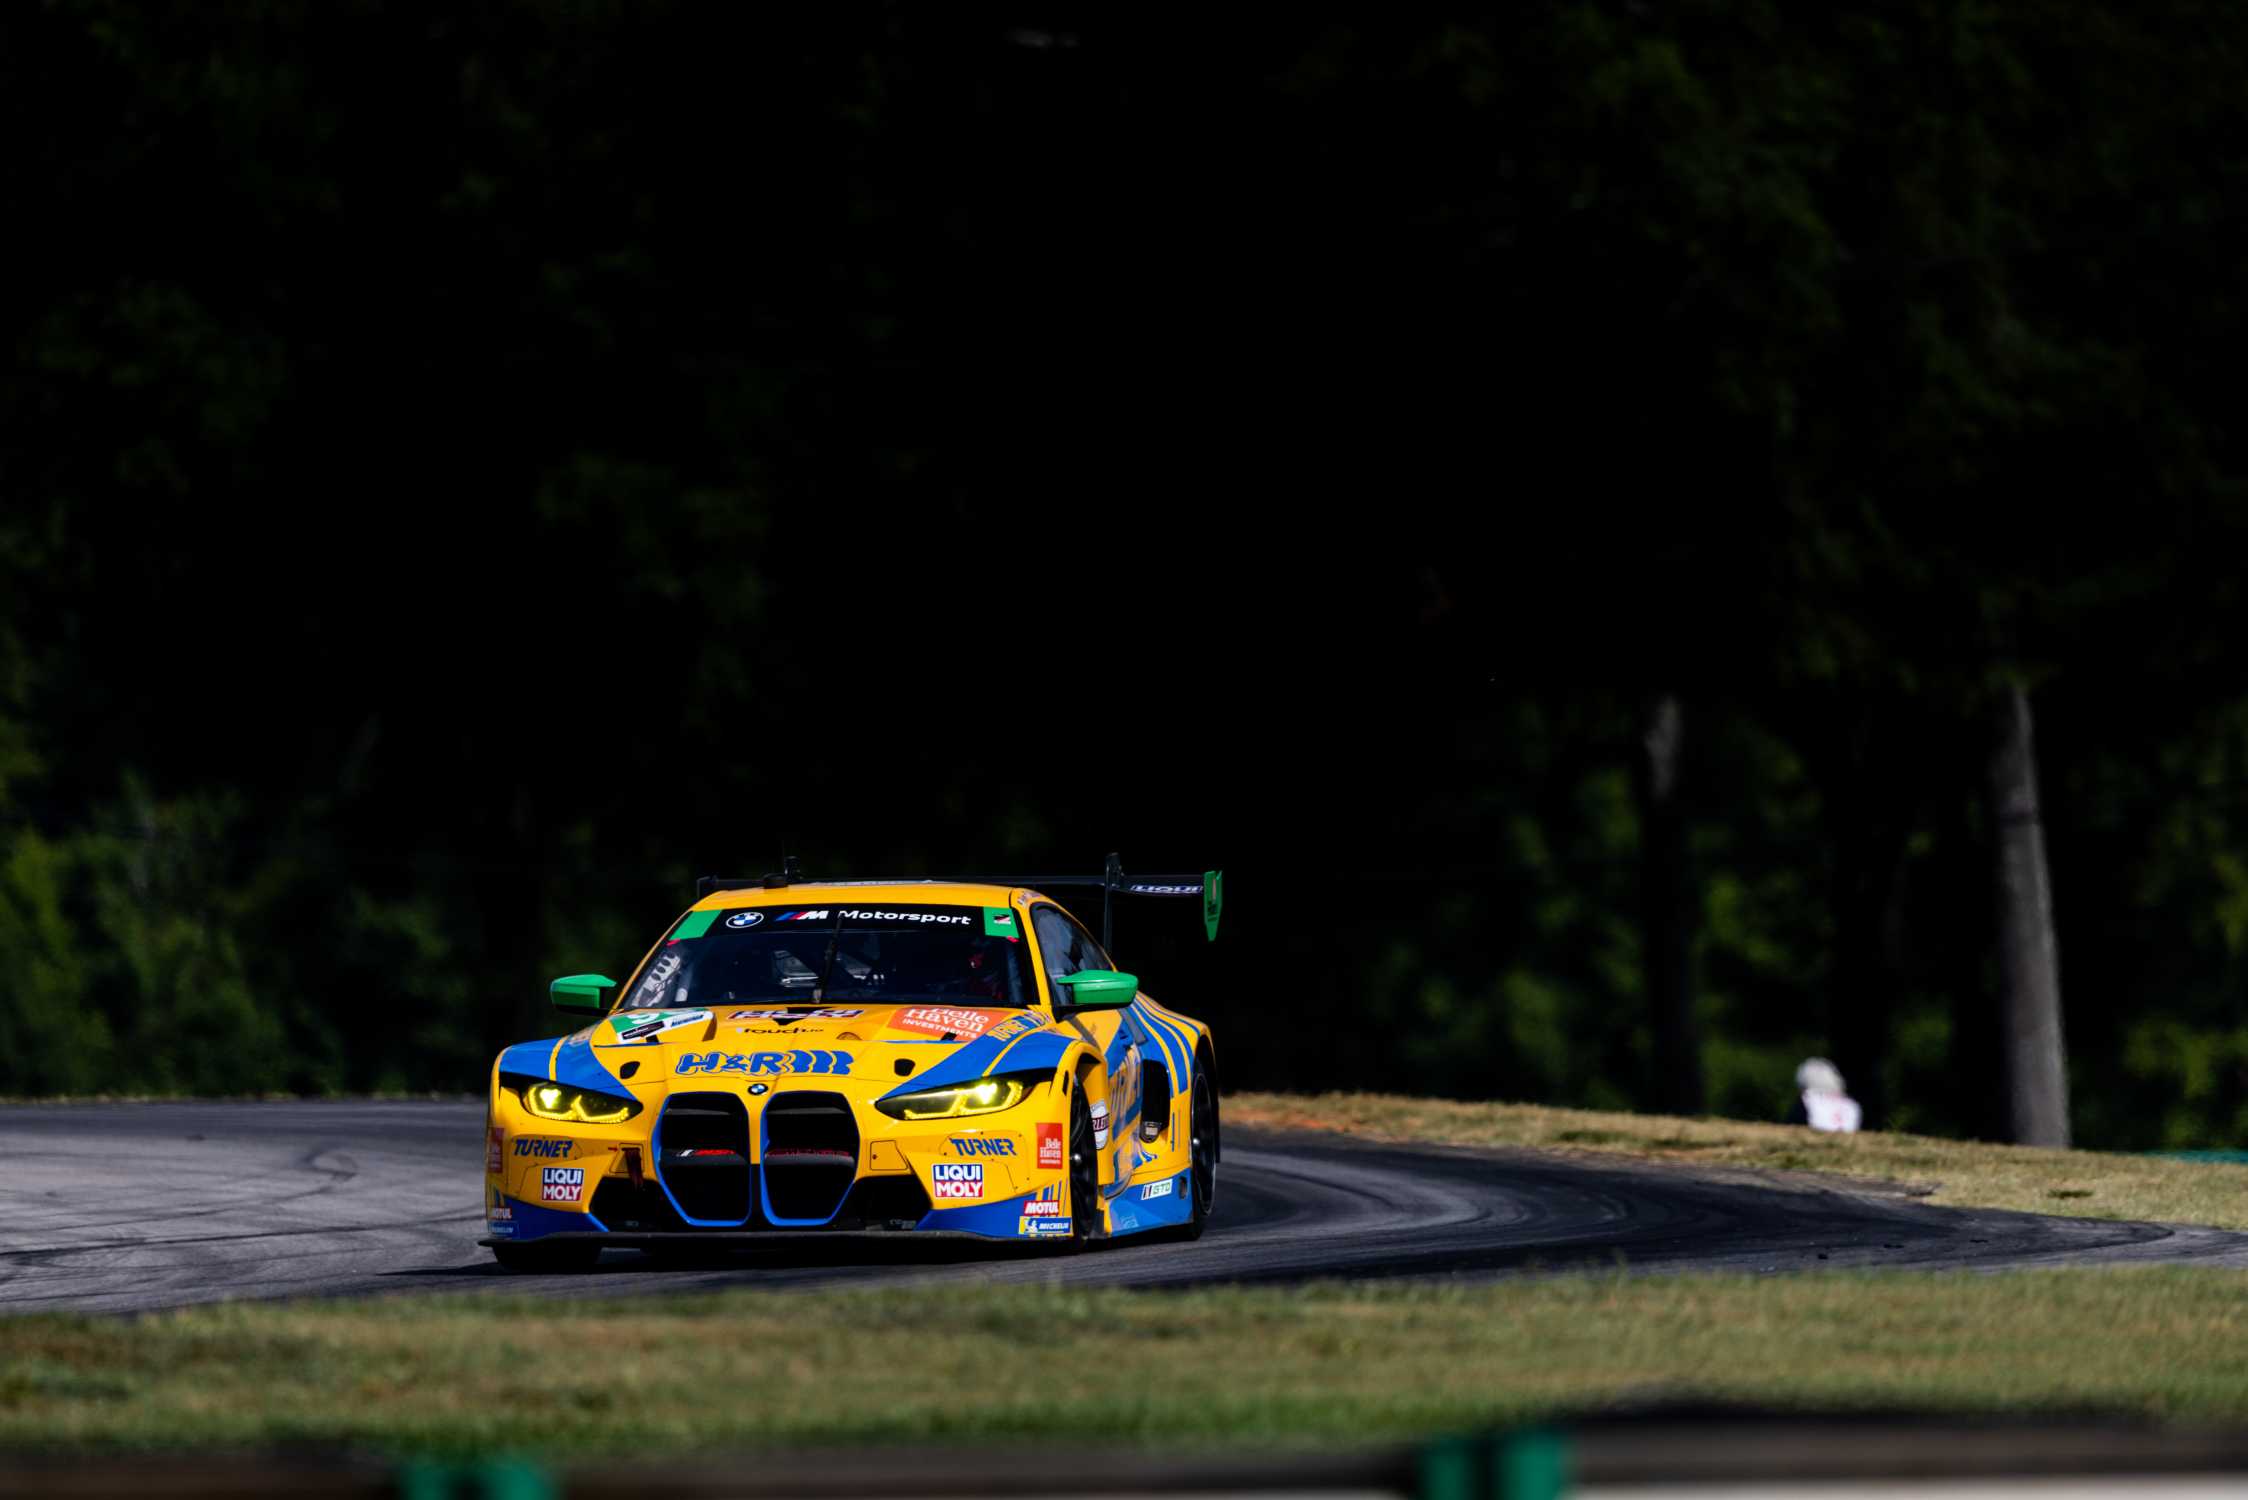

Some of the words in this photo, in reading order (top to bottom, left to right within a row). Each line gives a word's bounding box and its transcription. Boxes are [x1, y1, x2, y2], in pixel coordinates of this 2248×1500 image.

[838, 910, 972, 925] Motorsport
[902, 1018, 978, 1039] INVESTMENTS
[904, 1008, 985, 1033] Haven
[675, 1052, 790, 1076] H&R
[514, 1138, 573, 1158] TURNER
[949, 1138, 1017, 1156] TURNER
[543, 1168, 583, 1185] LIQUI
[934, 1165, 981, 1181] LIQUI
[542, 1185, 581, 1200] MOLY
[935, 1181, 983, 1198] MOLY
[1024, 1201, 1059, 1214] MOTUL
